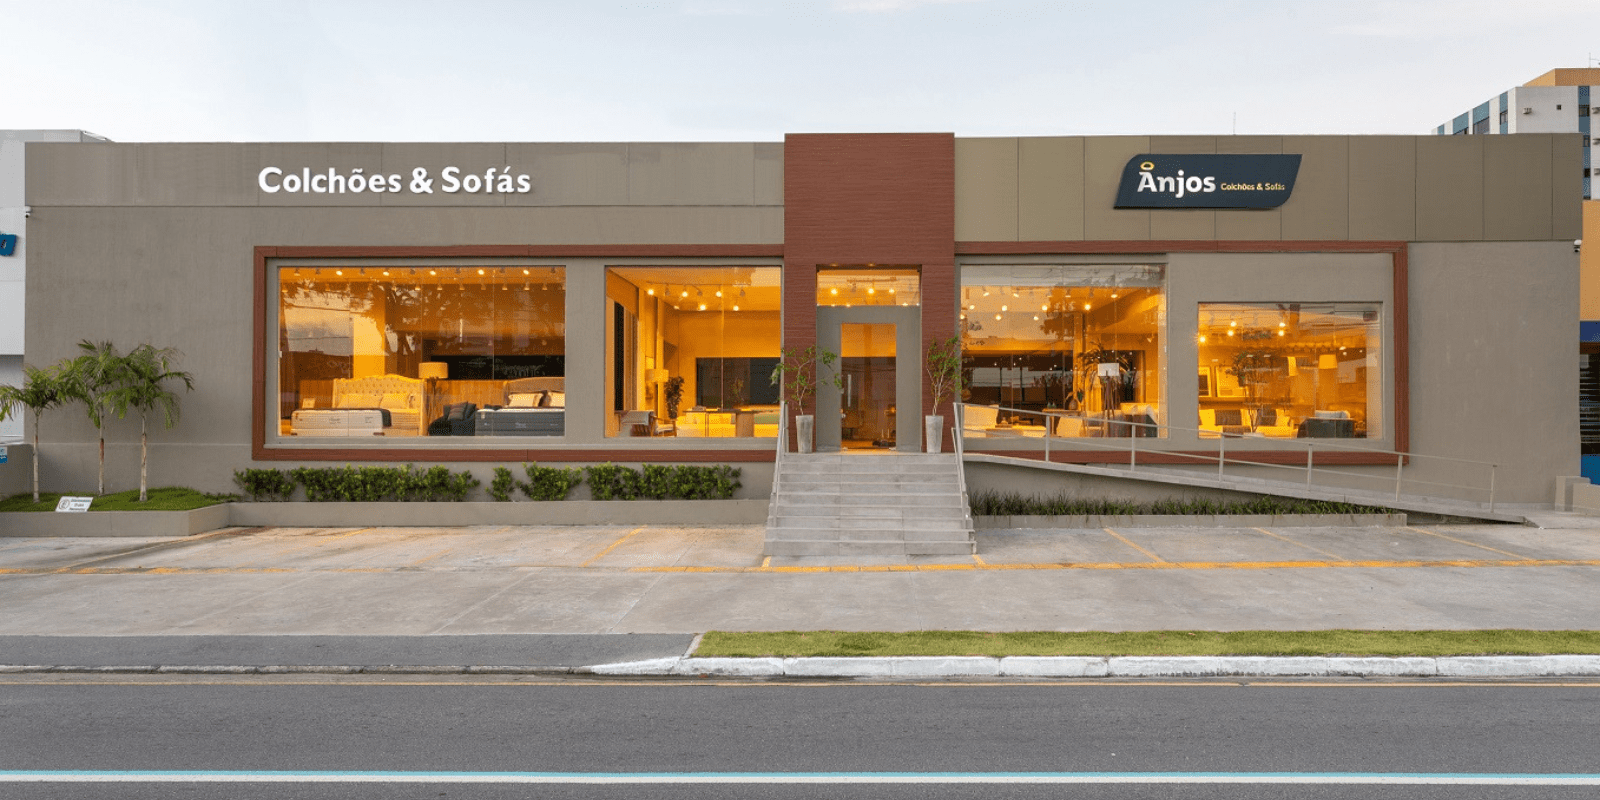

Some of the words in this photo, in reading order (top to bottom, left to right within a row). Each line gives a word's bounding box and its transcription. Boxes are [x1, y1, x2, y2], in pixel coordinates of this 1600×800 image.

[258, 166, 402, 193] Colchões
[409, 167, 434, 194] &
[441, 166, 531, 193] Sofás
[1137, 169, 1216, 198] Anjos
[1220, 182, 1255, 191] Colchões
[1256, 182, 1264, 191] &
[1265, 182, 1286, 191] Sofás
